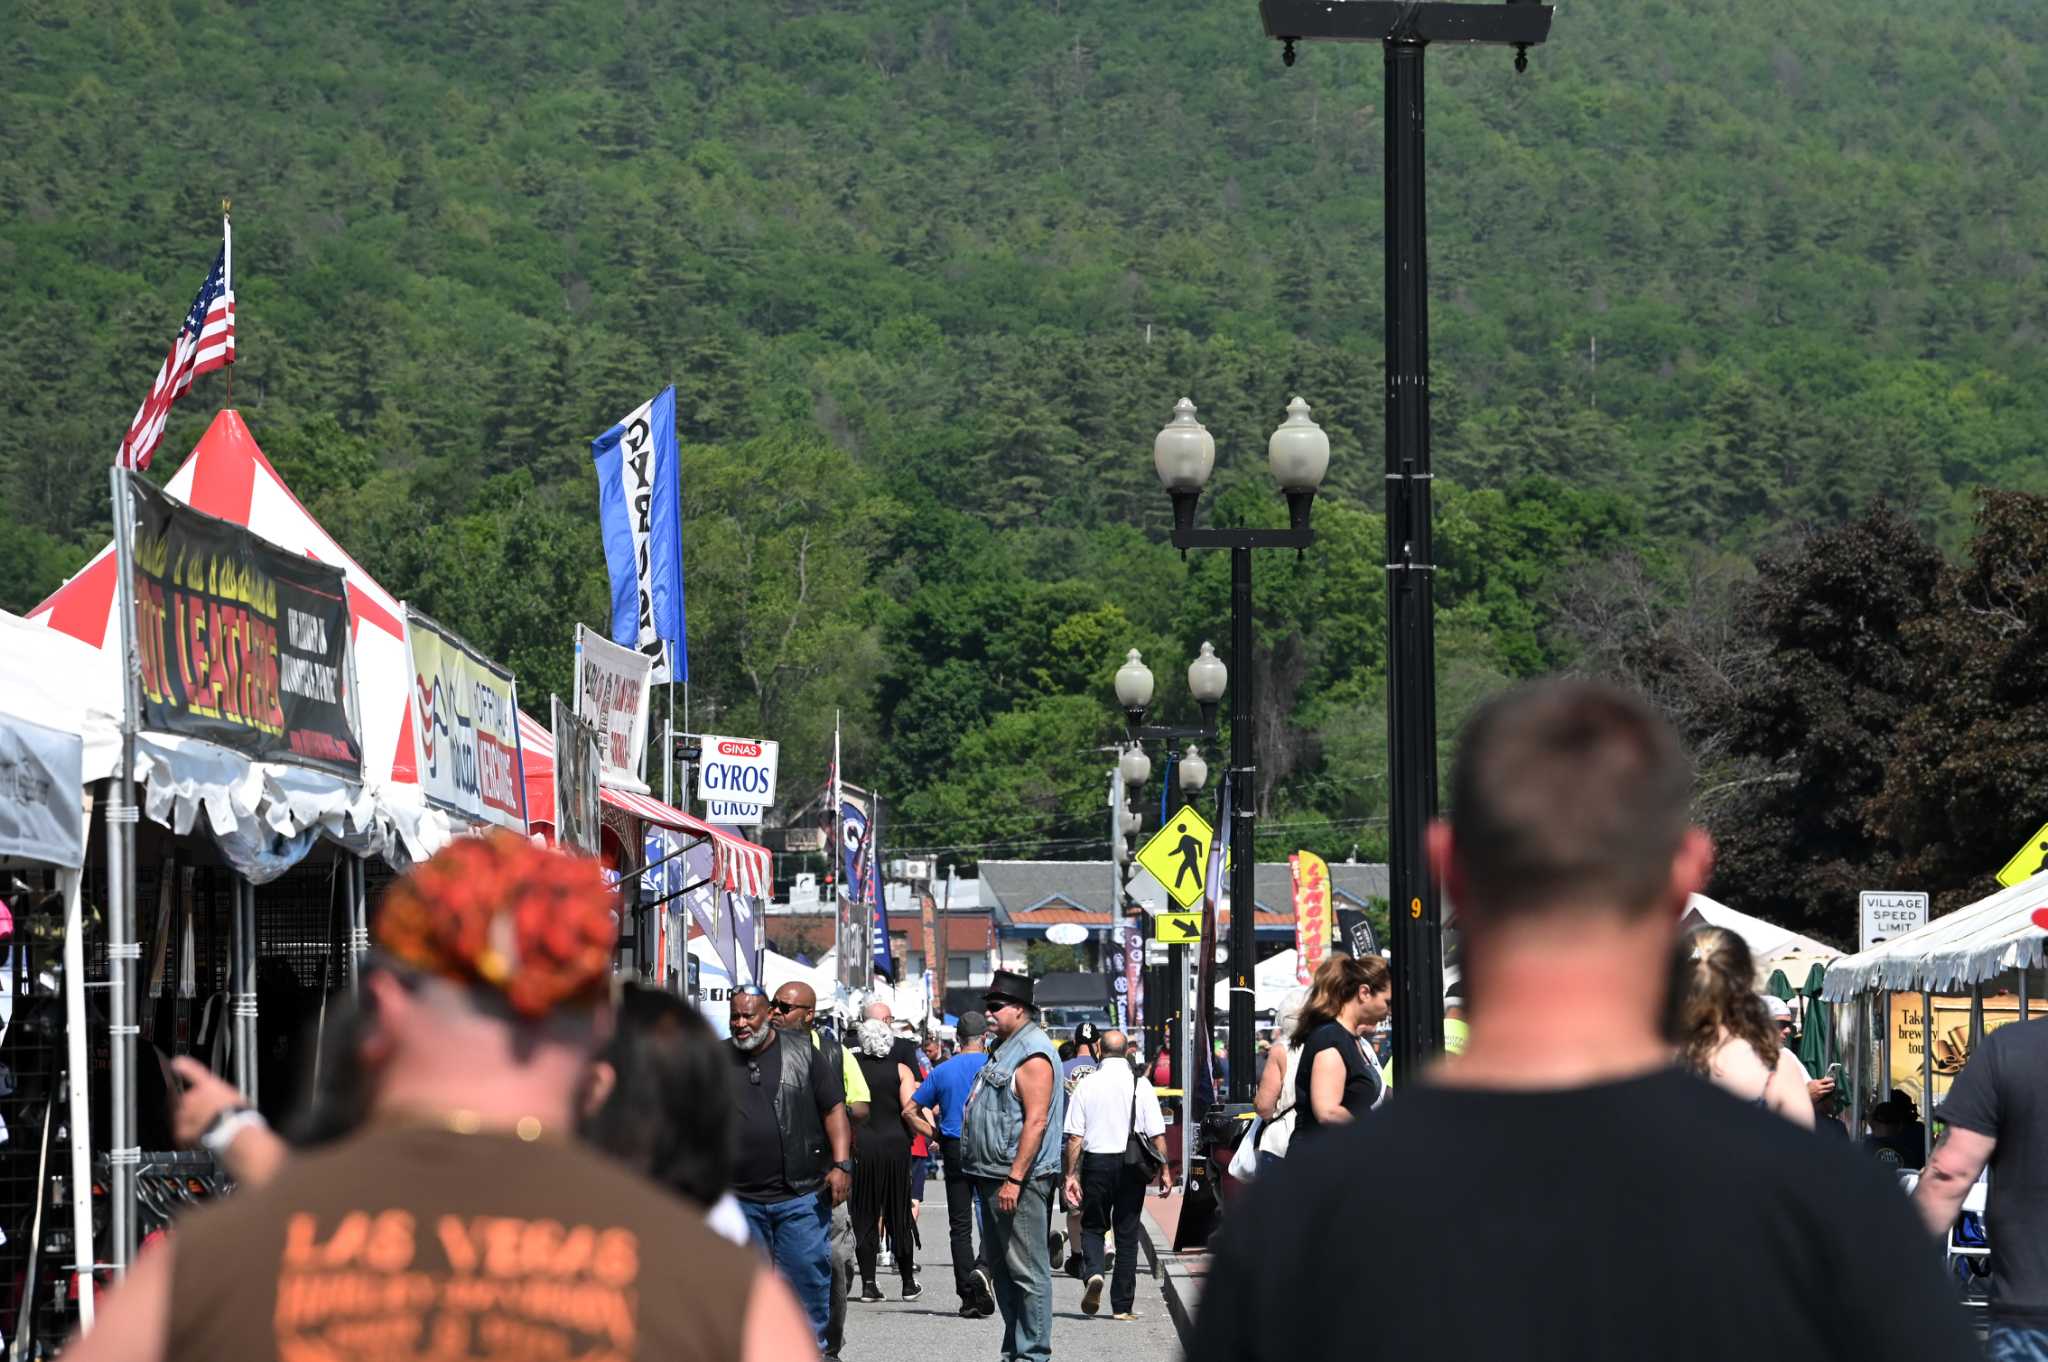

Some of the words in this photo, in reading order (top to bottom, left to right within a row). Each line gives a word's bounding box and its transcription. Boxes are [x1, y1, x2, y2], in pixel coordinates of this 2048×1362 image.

[722, 743, 757, 756] GINAS
[704, 762, 769, 794] GYROS
[1411, 897, 1421, 918] 9
[1867, 899, 1922, 909] VILLAGE
[1873, 911, 1917, 920] SPEED
[1878, 922, 1912, 932] LIMIT
[1898, 1024, 1938, 1042] brewy
[1908, 1041, 1925, 1054] tou
